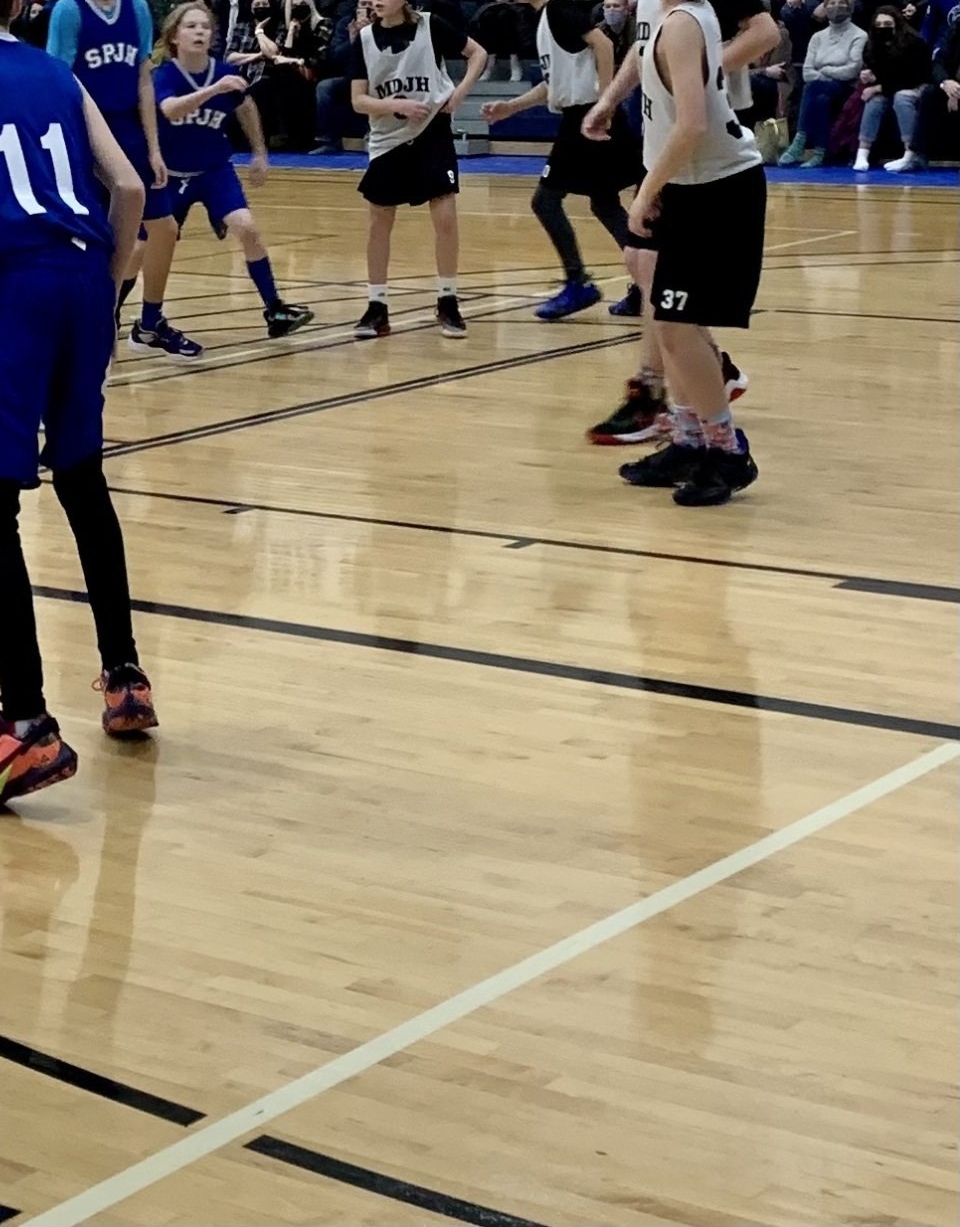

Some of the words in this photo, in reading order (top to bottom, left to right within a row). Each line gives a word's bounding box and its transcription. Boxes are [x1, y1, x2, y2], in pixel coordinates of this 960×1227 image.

[84, 42, 139, 69] SPJH
[374, 75, 430, 100] MDJH
[660, 288, 689, 311] 37
